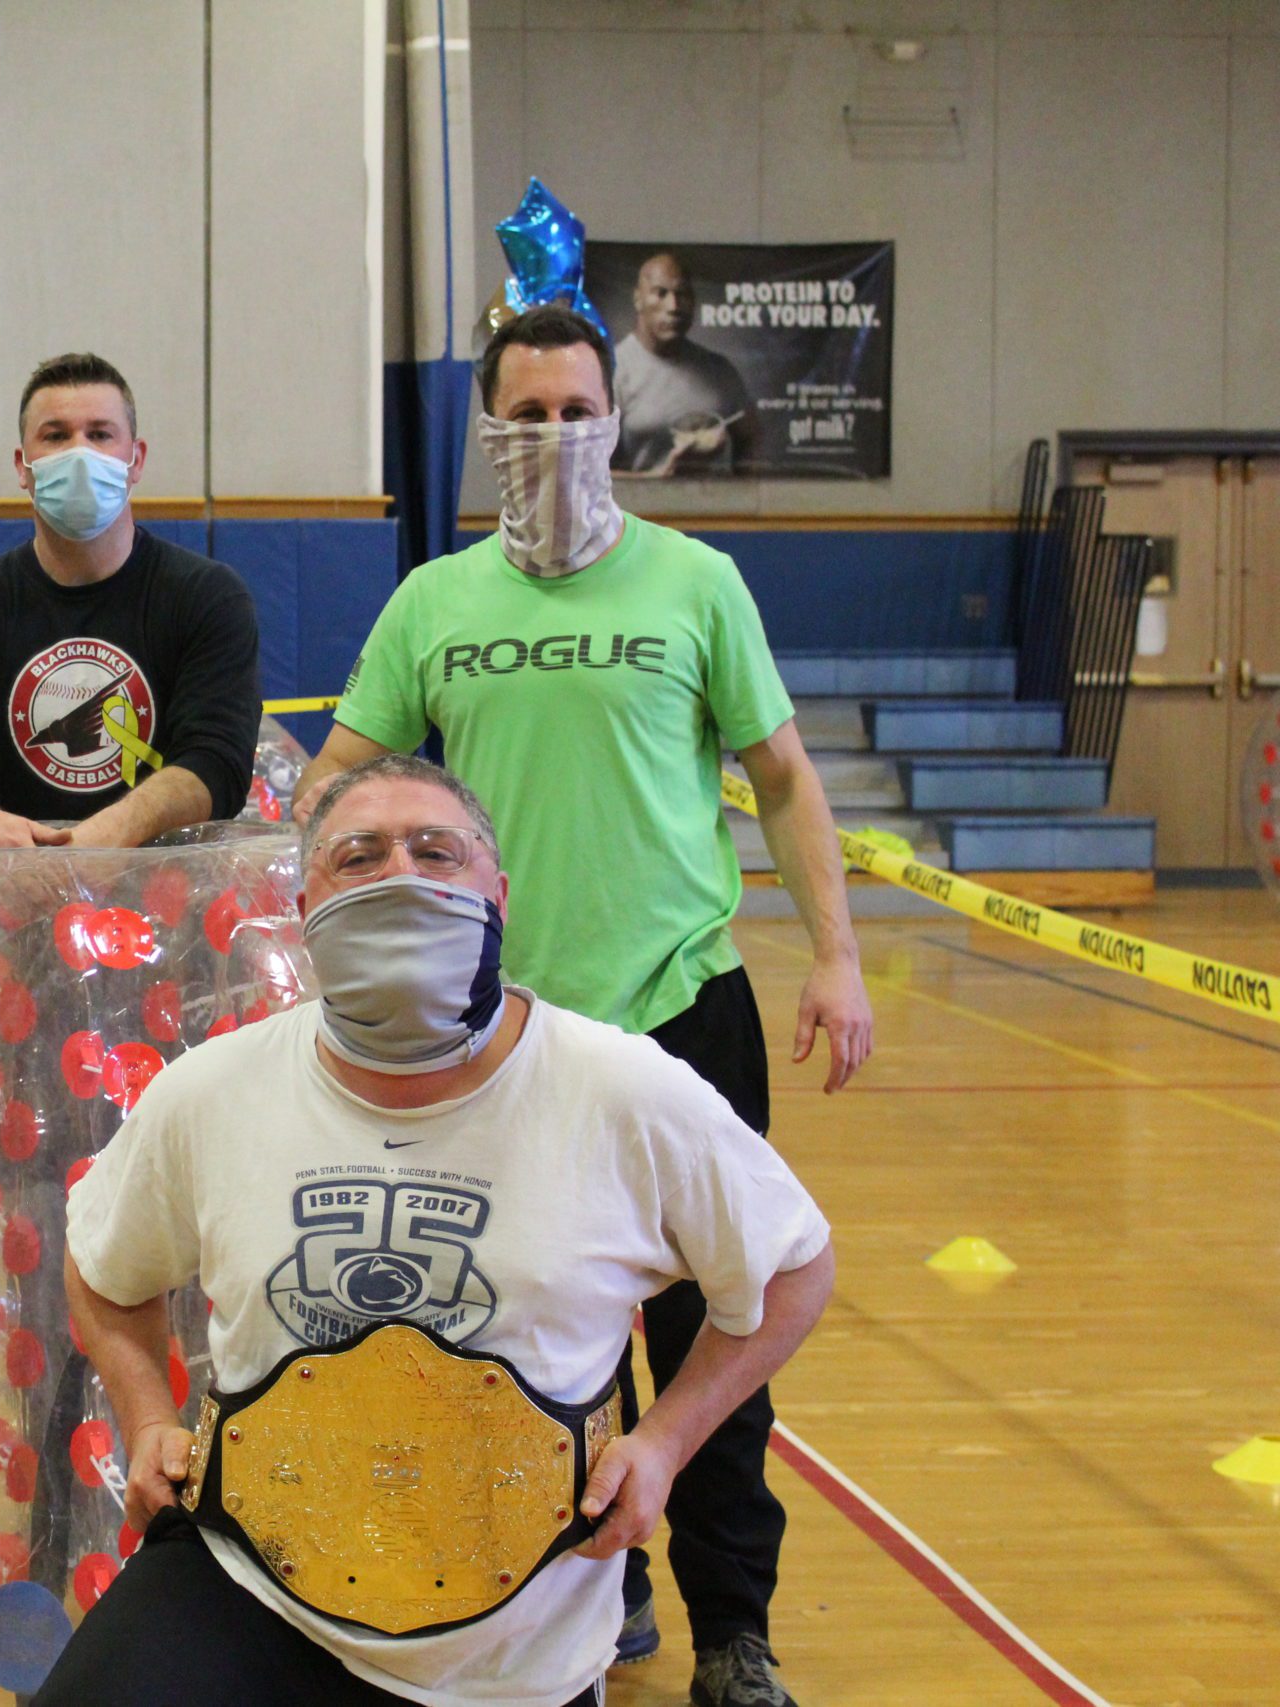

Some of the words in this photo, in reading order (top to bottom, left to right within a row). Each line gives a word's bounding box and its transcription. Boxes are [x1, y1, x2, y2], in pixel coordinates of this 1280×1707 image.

[725, 281, 823, 303] PROTEIN
[827, 280, 855, 303] TO
[701, 304, 762, 327] ROCK
[768, 304, 826, 327] YOUR
[831, 304, 881, 327] DAY.
[789, 415, 812, 445] got
[815, 412, 855, 440] milk?
[30, 644, 127, 678] BLACKHAWKS
[444, 634, 667, 682] ROGUE
[45, 762, 121, 784] BASEBALL
[902, 863, 952, 901] CAUTION
[984, 895, 1040, 936] CAUTION
[1079, 927, 1144, 973] CAUTION
[1193, 961, 1271, 1011] CAUTION
[295, 1169, 317, 1180] PENN
[320, 1166, 343, 1175] STATE
[347, 1165, 386, 1174] FOOTBALL
[398, 1168, 437, 1178] SUCCESS
[440, 1172, 462, 1182] WITH
[463, 1175, 493, 1190] HONOR
[309, 1191, 369, 1207] 1982
[406, 1194, 472, 1216] 2007
[293, 1180, 490, 1308] 25
